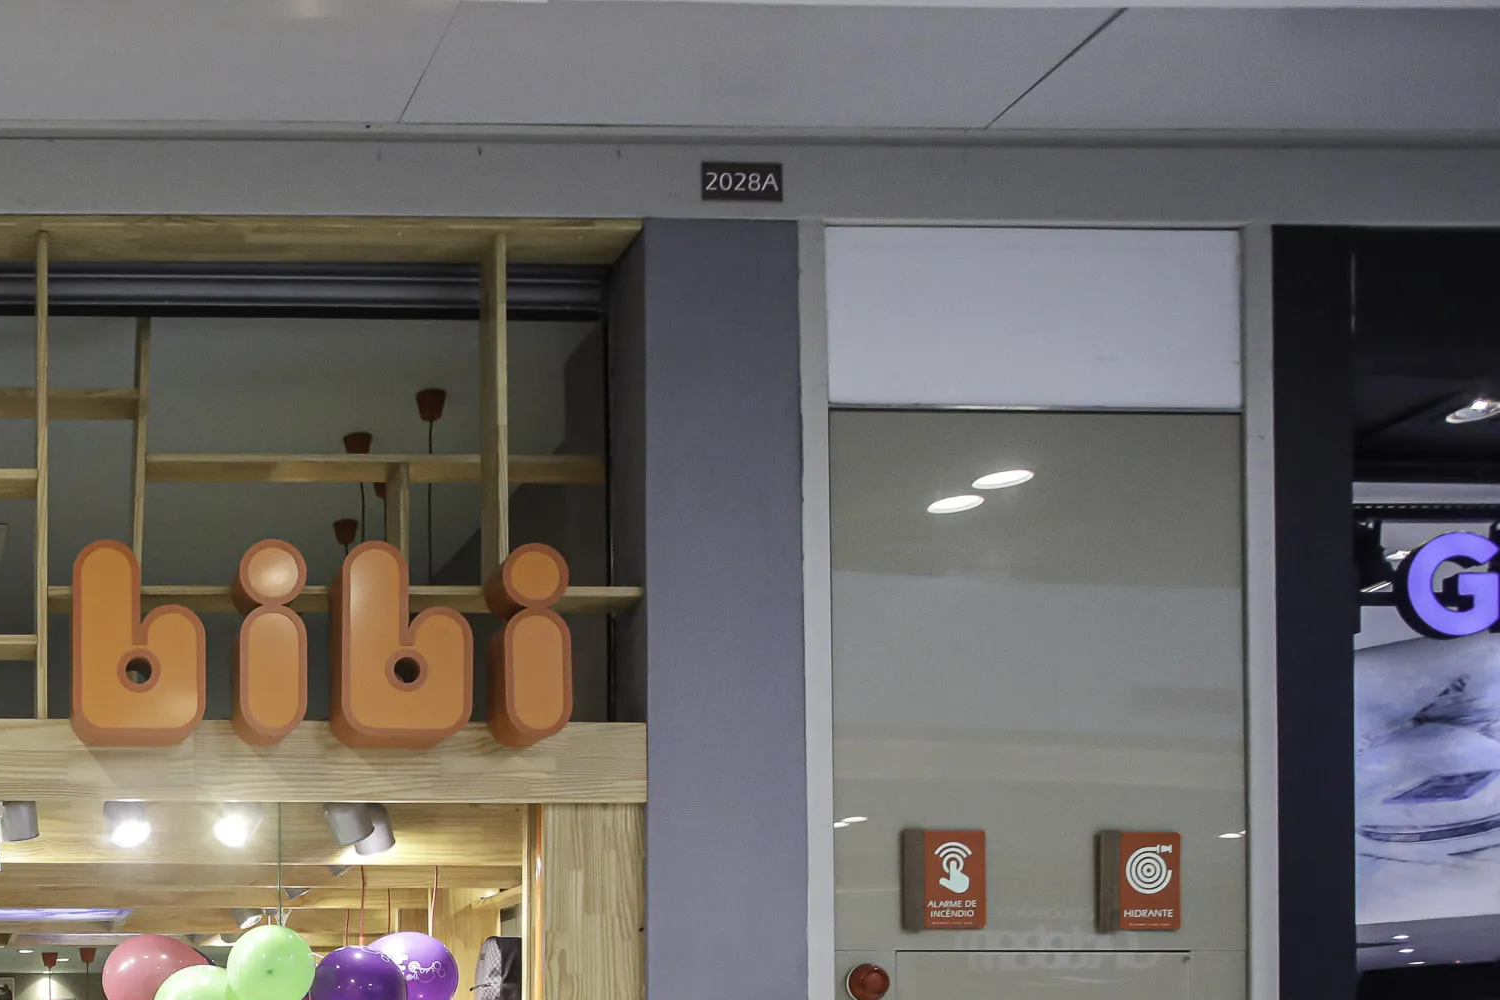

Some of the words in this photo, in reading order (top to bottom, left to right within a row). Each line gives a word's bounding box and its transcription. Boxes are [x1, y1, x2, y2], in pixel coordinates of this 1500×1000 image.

[705, 171, 779, 192] 2028A
[70, 538, 574, 750] bibi
[927, 900, 963, 909] ALARME
[964, 899, 977, 908] DE
[930, 907, 975, 918] INCÊNDIO
[1123, 908, 1175, 919] HIDRANTE
